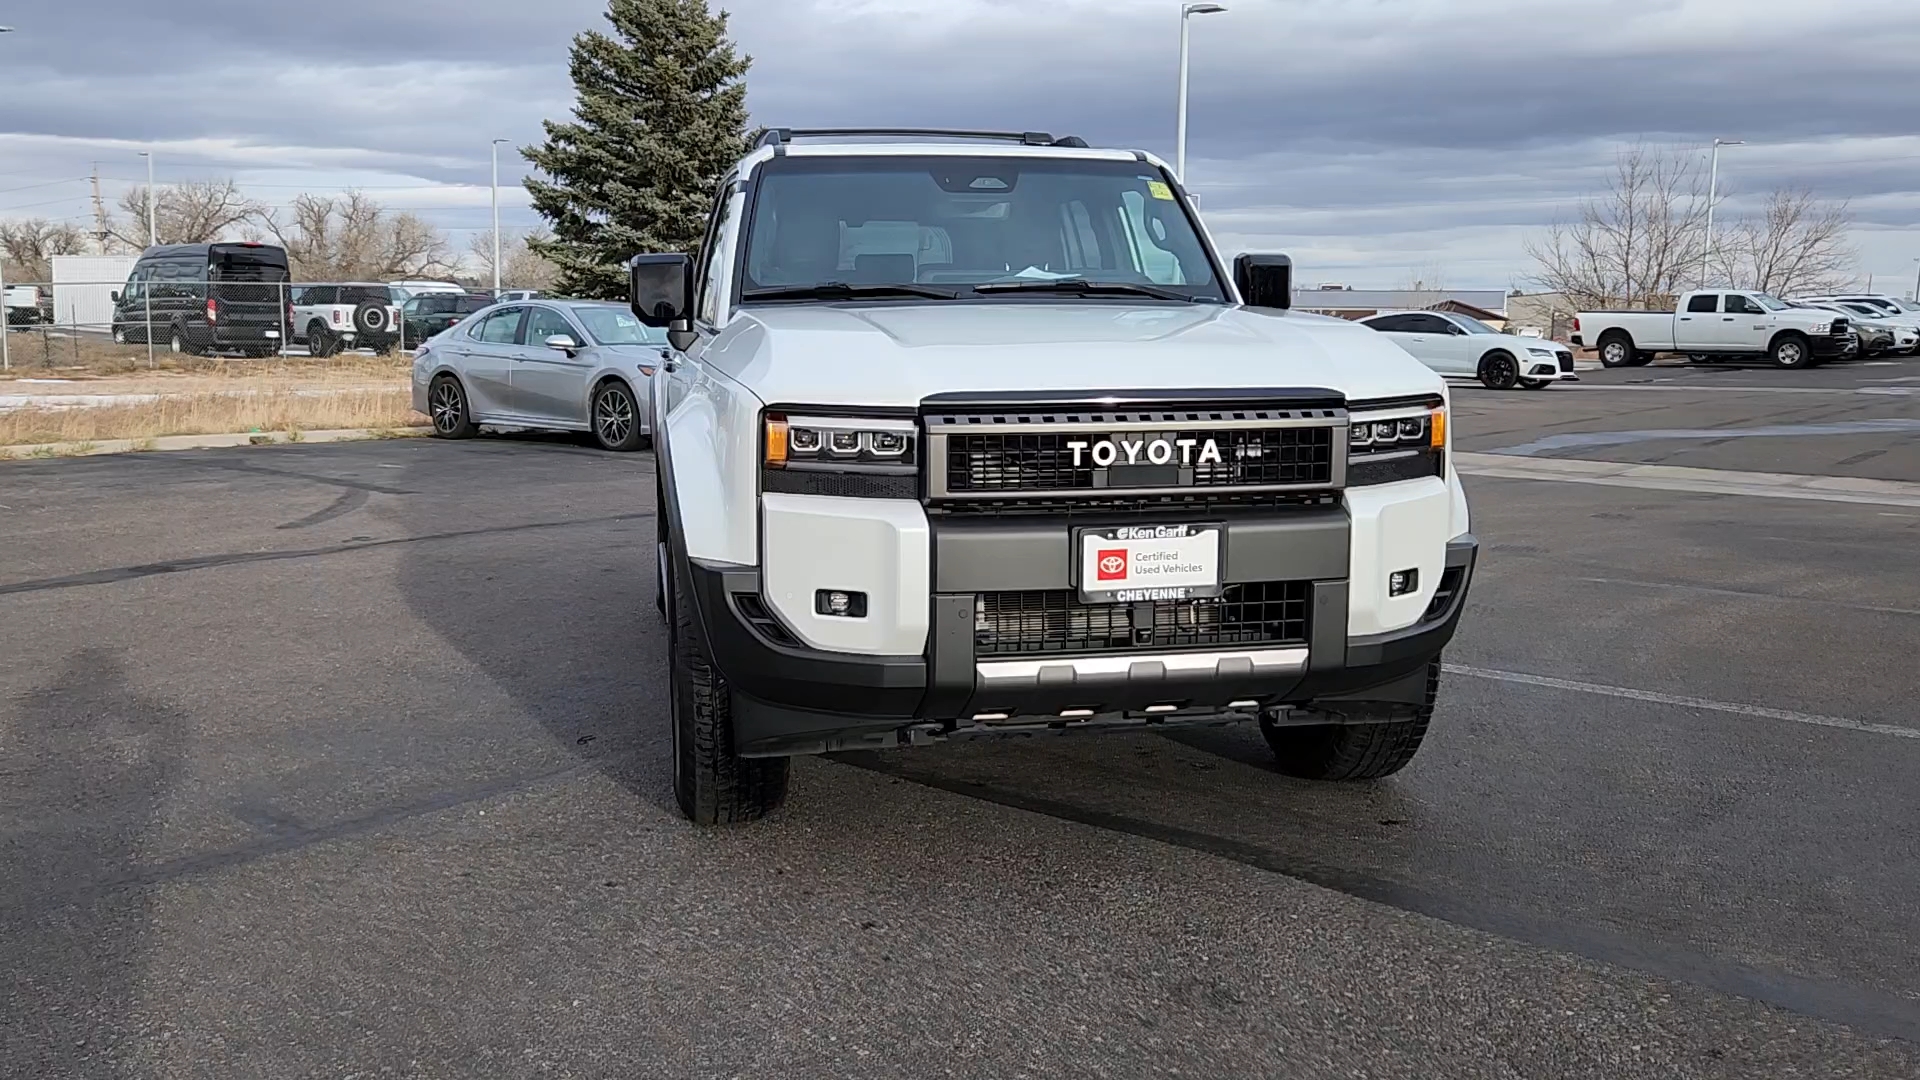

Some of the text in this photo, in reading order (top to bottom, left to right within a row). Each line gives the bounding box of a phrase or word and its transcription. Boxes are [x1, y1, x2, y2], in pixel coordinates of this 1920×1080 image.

[1067, 439, 1222, 466] TOYOTA
[1135, 551, 1178, 561] Certified
[1135, 563, 1203, 574] Used Vehicles
[1117, 587, 1186, 602] CHEYENNE
